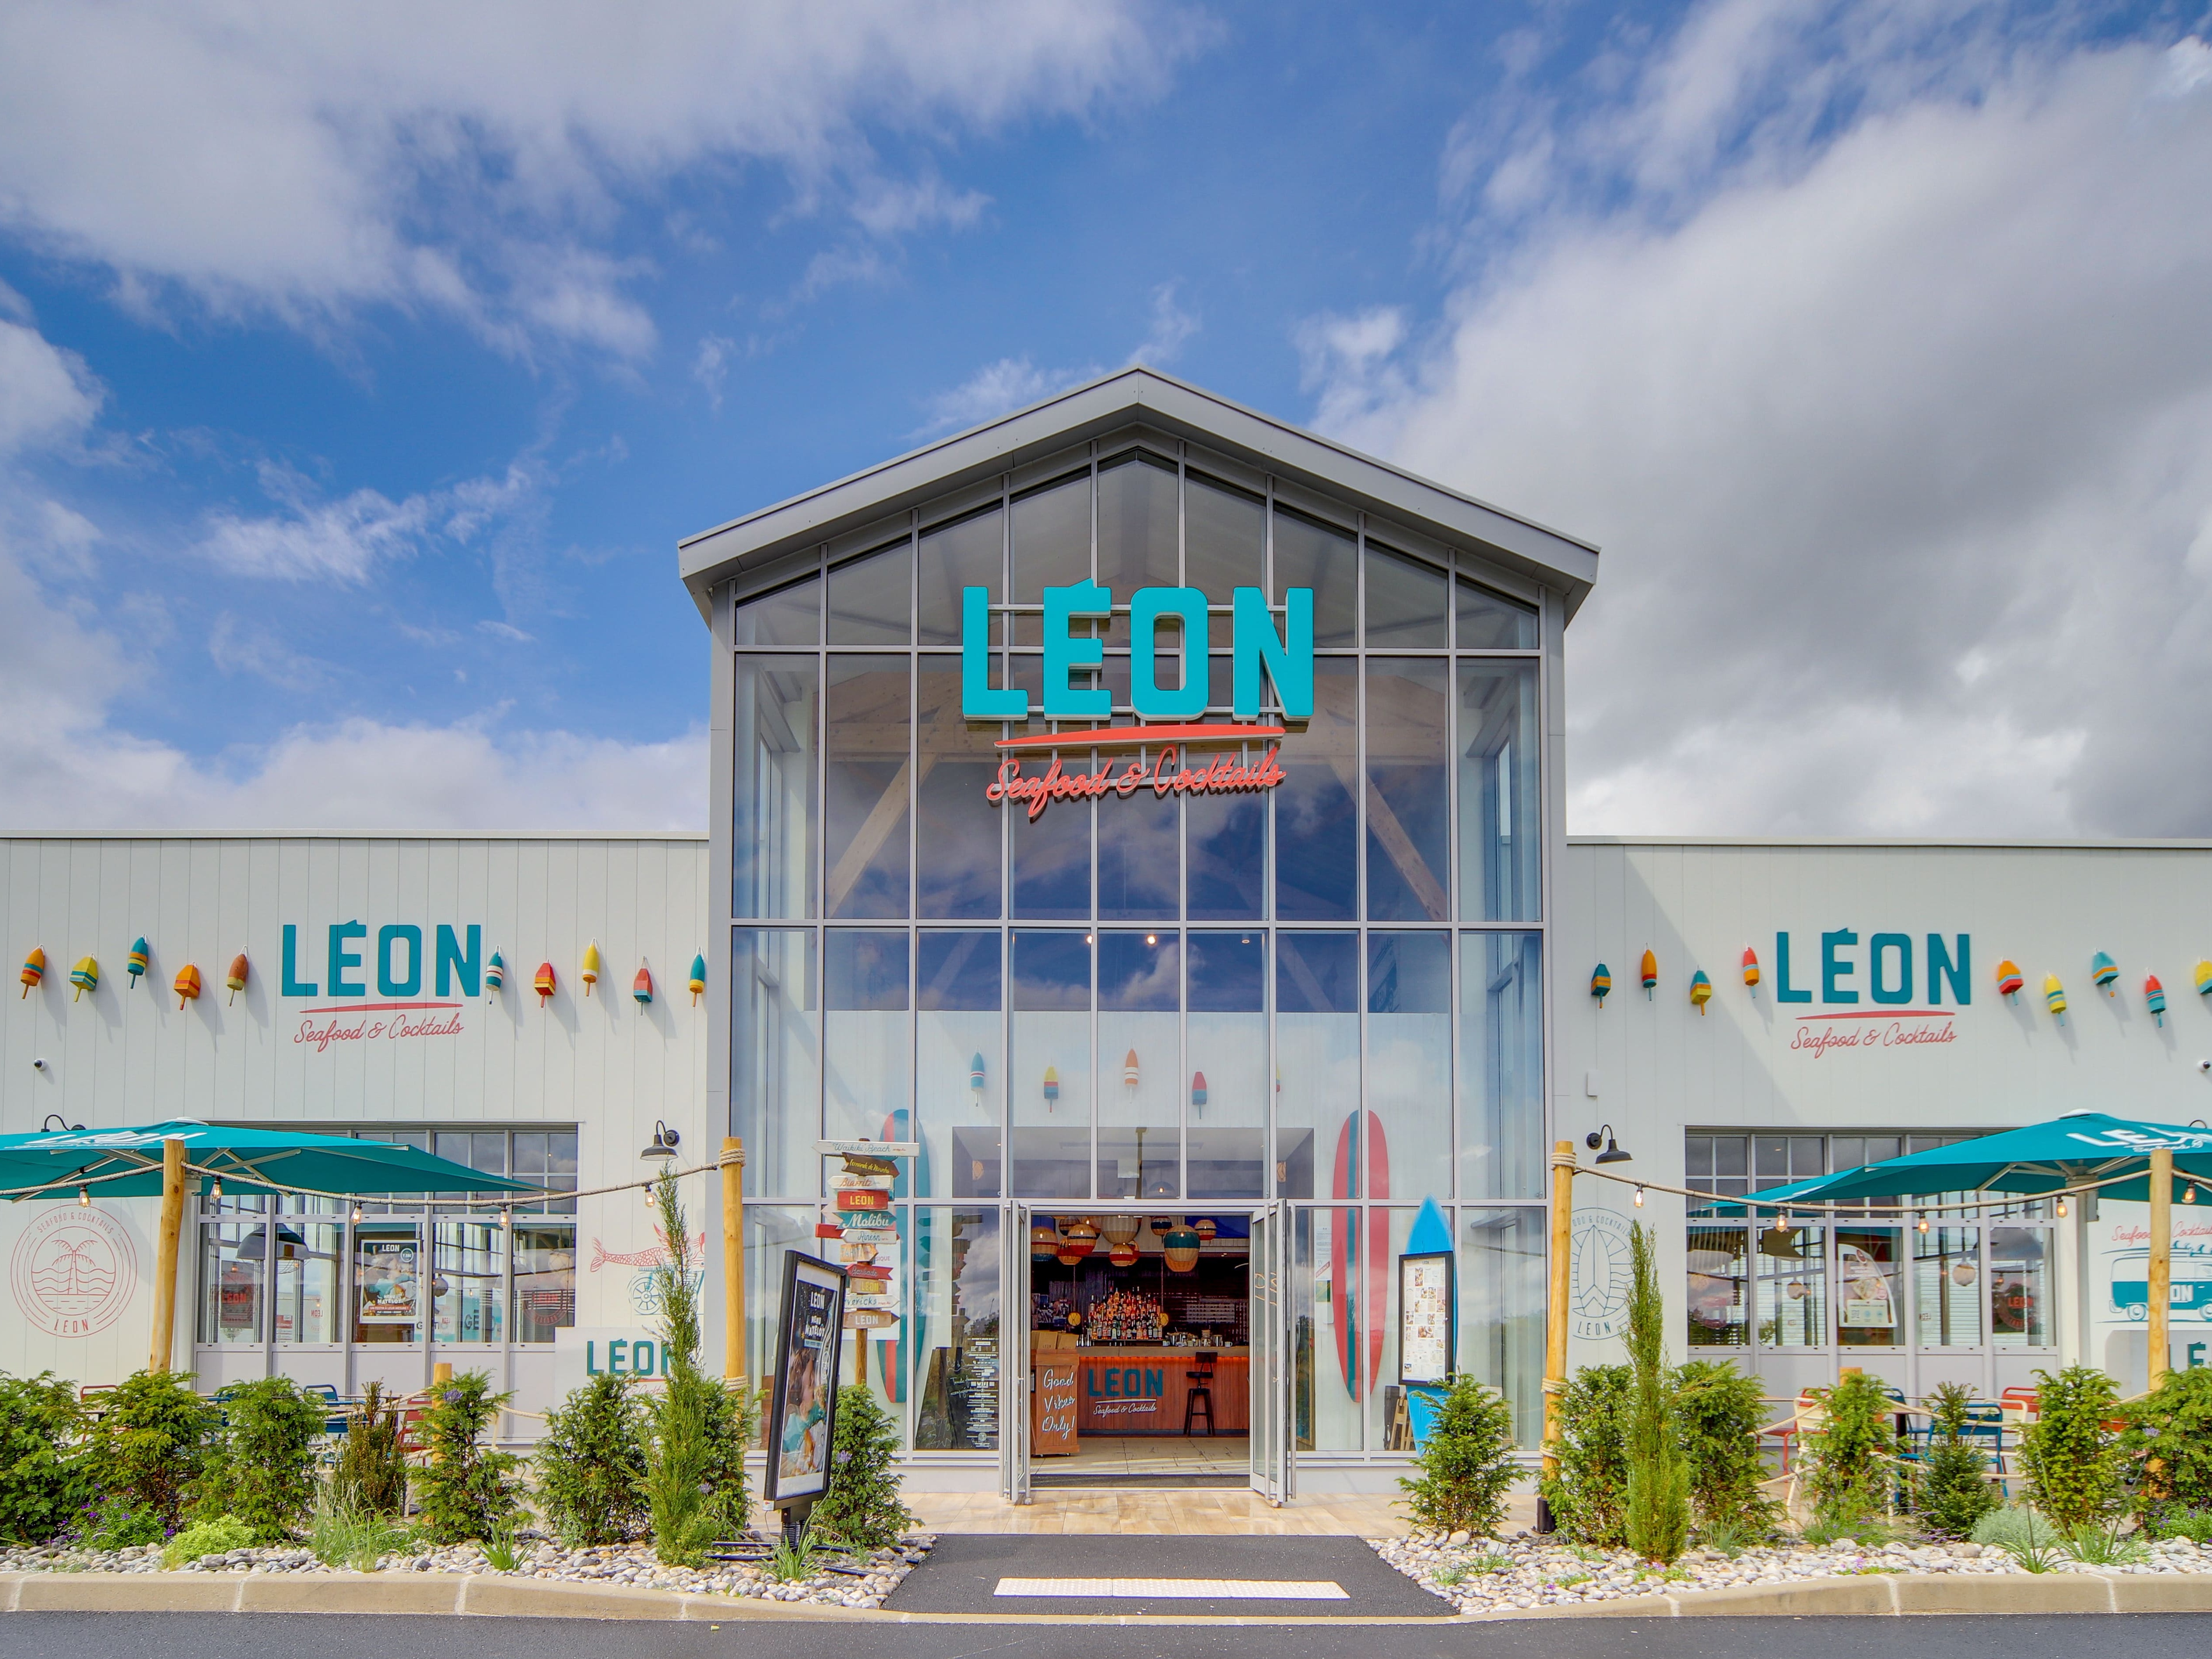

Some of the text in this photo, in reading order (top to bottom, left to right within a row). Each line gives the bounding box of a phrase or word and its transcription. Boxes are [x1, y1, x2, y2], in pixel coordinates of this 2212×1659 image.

[986, 744, 1287, 820] Seafood & Cocktails
[294, 1013, 464, 1052] Seafood & Cocktails
[1791, 1021, 1958, 1059] Seafood & Cocktails
[833, 1143, 864, 1152] Waikiki
[865, 1145, 891, 1153] Beach
[840, 1178, 872, 1187] Biarritz
[37, 1213, 67, 1233] SEAFOOD
[78, 1213, 114, 1234] COCKTAILS
[843, 1214, 889, 1227] Malibu
[2112, 1226, 2150, 1247] Seafoo
[845, 1296, 877, 1306] vericks
[2170, 1284, 2194, 1302] ON
[1044, 1368, 1074, 1390] Good
[1044, 1394, 1075, 1413] Vibes
[1093, 1404, 1120, 1418] Seafood
[1128, 1402, 1156, 1414] Cocktails
[1042, 1415, 1075, 1440] Only!
